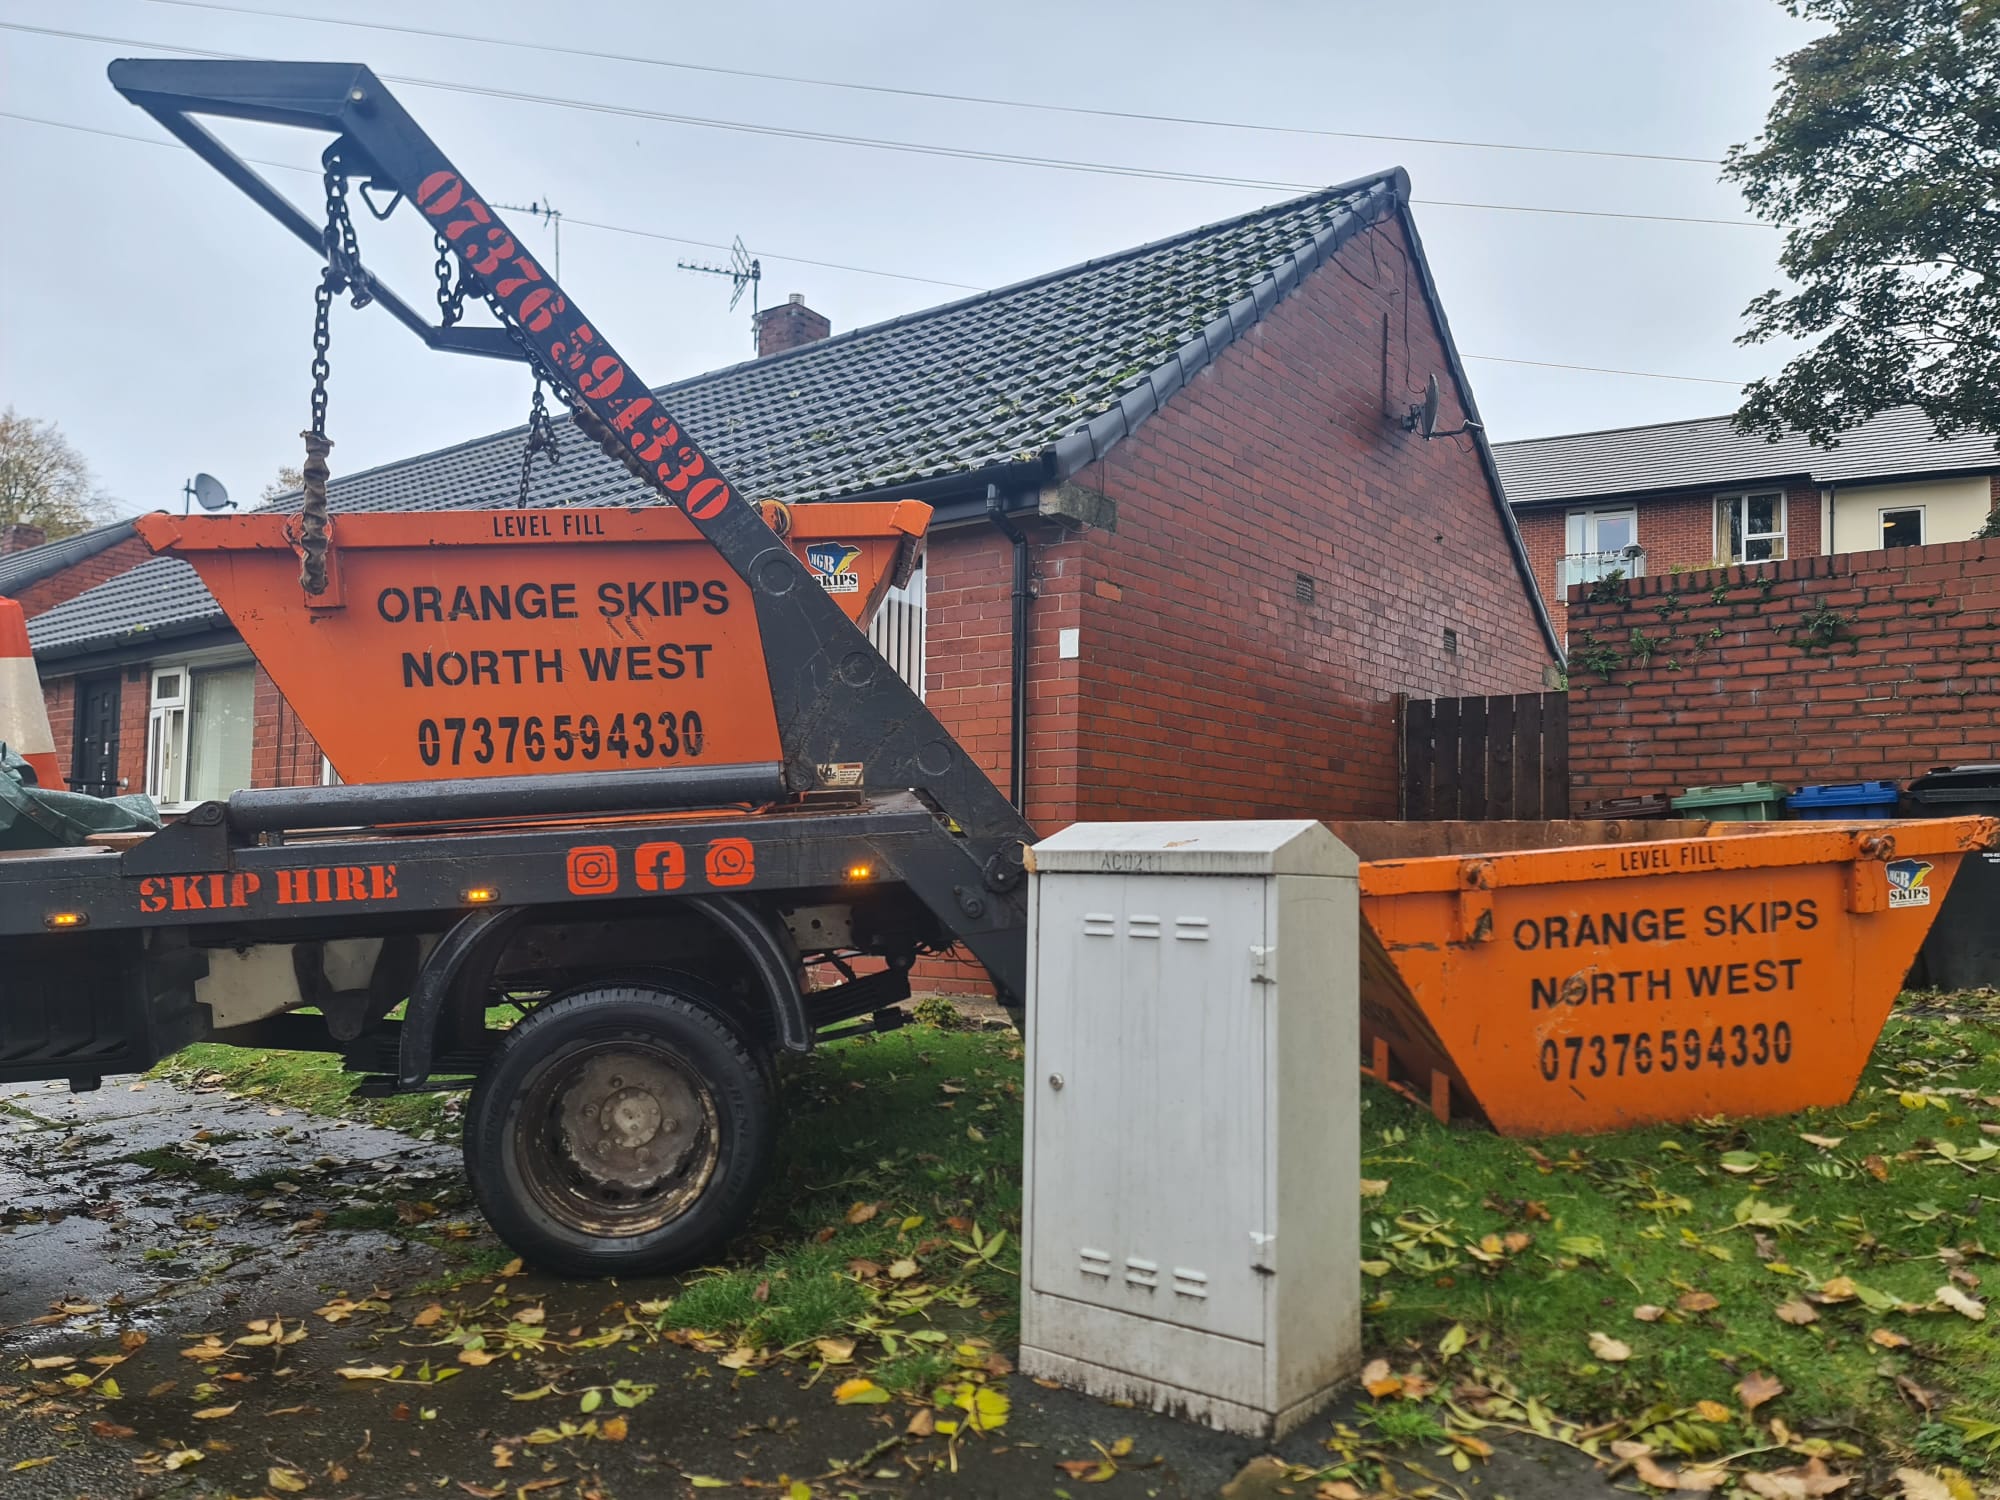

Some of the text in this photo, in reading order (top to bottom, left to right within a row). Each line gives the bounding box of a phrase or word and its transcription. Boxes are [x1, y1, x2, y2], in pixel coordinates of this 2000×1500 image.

[417, 170, 730, 520] 07376594330
[493, 515, 604, 537] LEVEL FILL
[377, 580, 730, 623] ORANGE SKIPS
[402, 643, 712, 687] NORTH WEST
[418, 710, 703, 766] 07376594330
[1620, 846, 1716, 872] LEVEL FILL
[140, 865, 397, 912] SKIP HIRE
[1890, 888, 1929, 900] SKIPS
[1513, 899, 1818, 950] ORANGE SKIPS
[1532, 959, 1802, 1009] NORTH WEST
[1540, 1021, 1791, 1081] 07376594330
